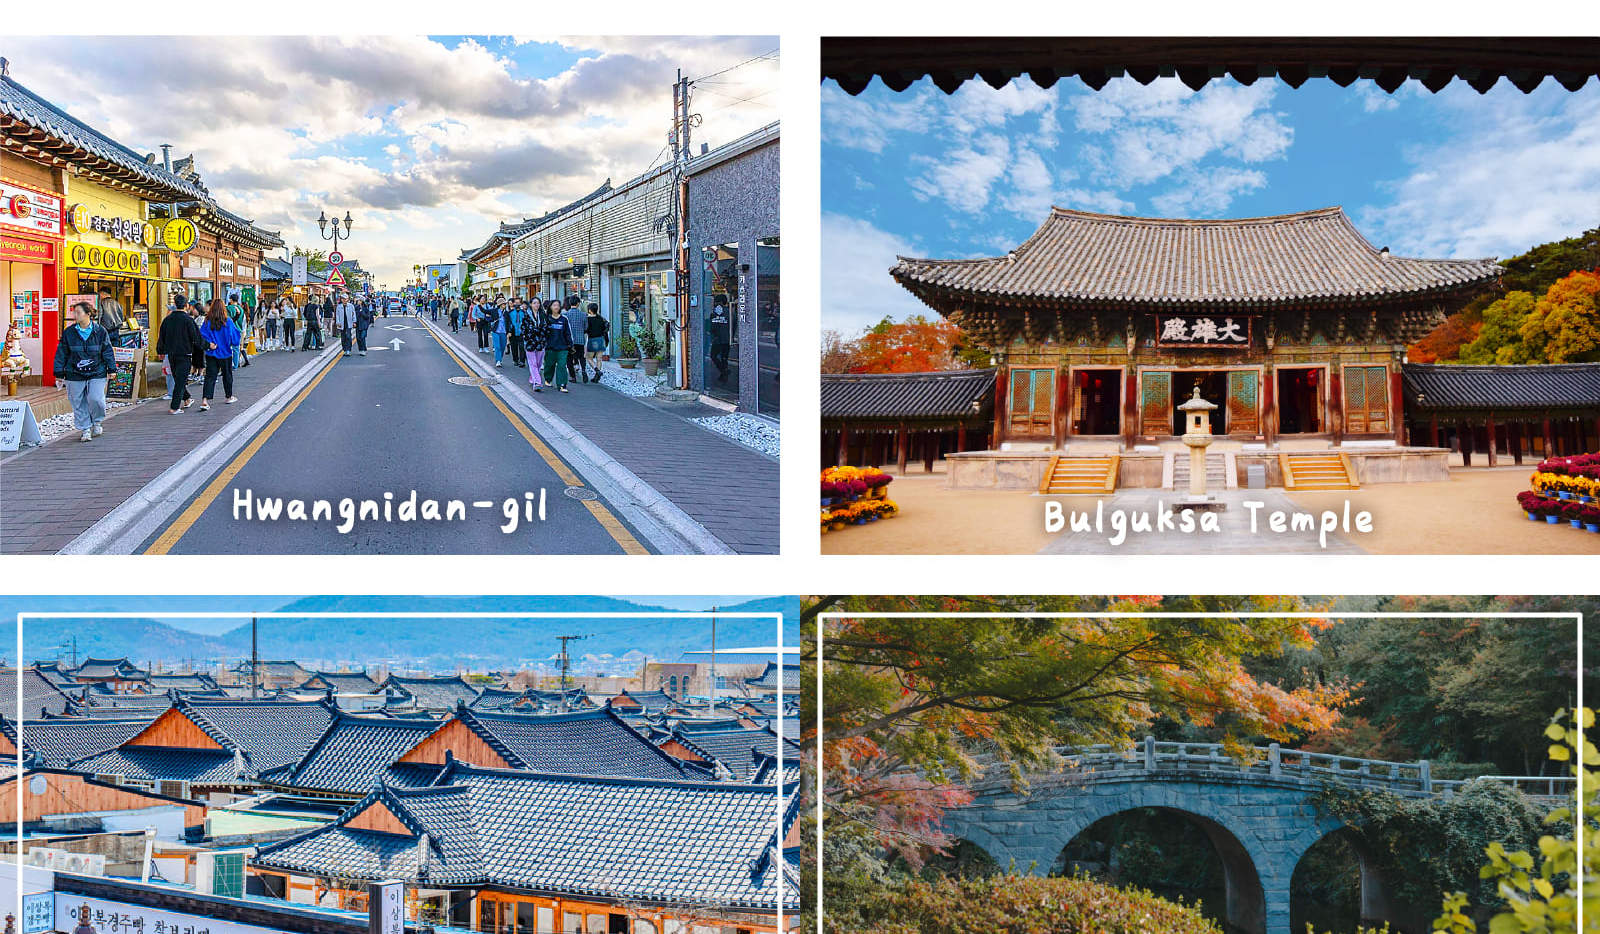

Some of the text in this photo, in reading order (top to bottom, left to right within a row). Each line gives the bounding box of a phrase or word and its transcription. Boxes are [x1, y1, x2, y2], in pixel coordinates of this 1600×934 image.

[178, 225, 192, 245] 10
[1160, 316, 1248, 344] 大雄殿
[0, 405, 19, 413] ostcard
[71, 904, 146, 934] 이복경주빵
